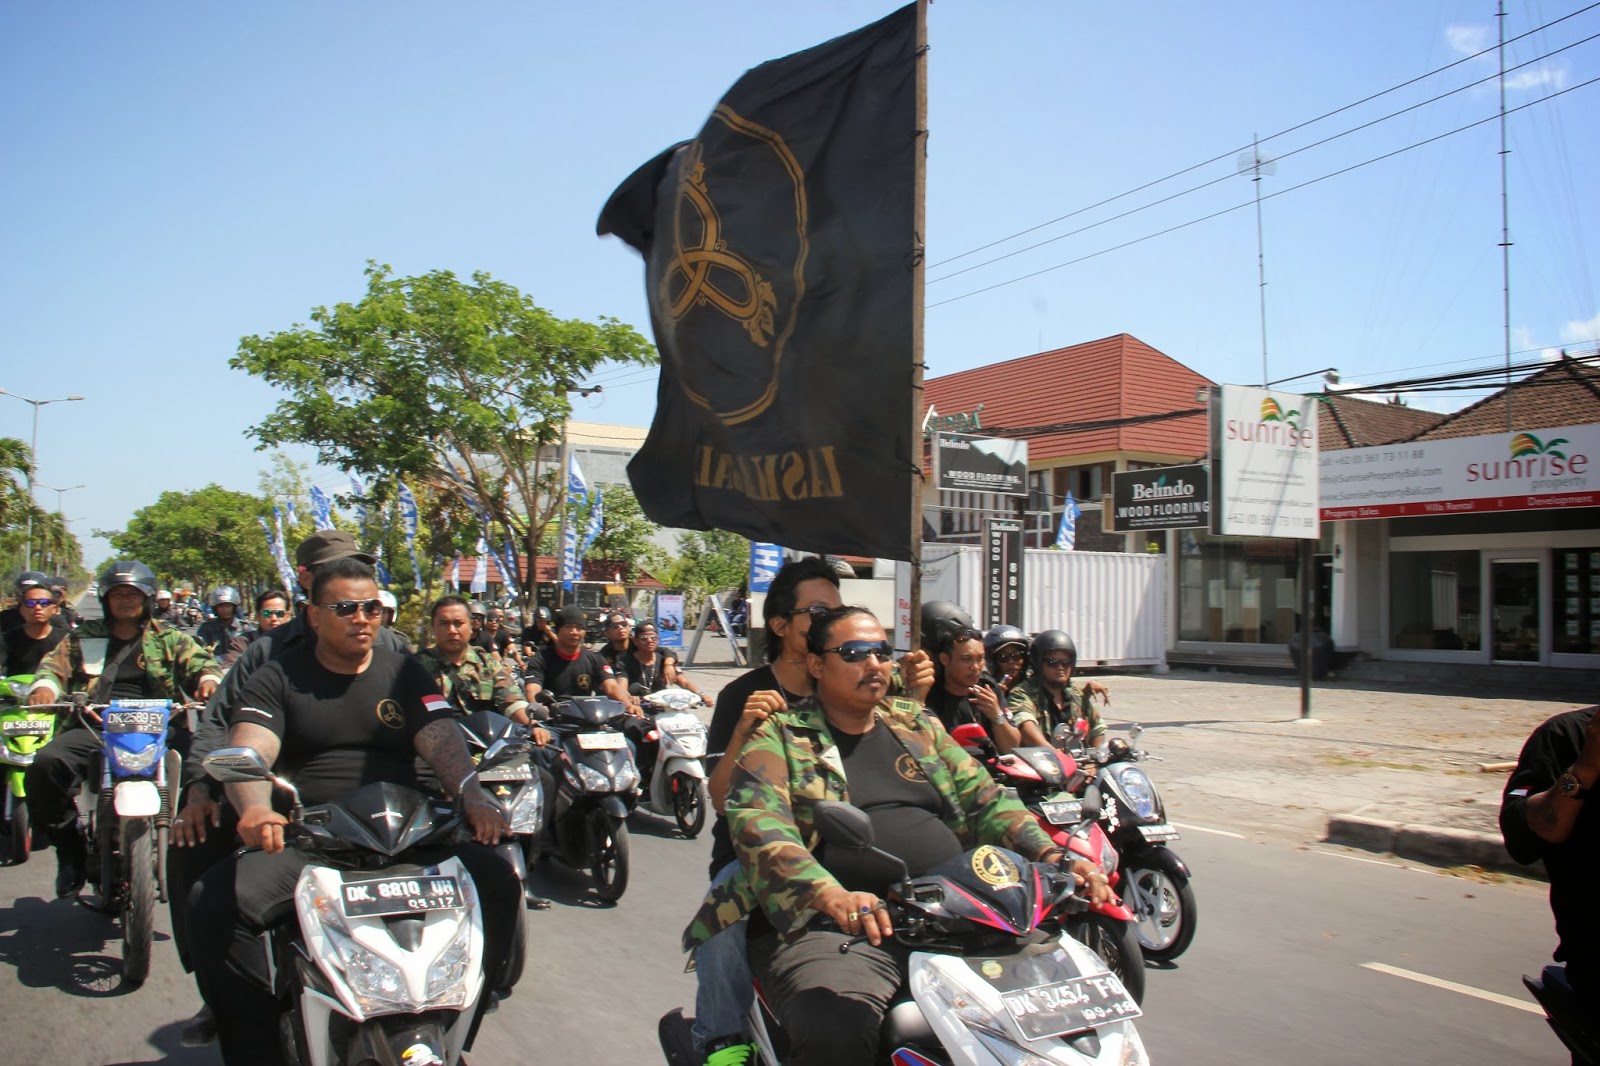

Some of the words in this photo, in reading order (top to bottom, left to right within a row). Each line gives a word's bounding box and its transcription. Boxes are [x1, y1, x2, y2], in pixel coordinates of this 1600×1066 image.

[1226, 419, 1313, 448] sunrise
[939, 438, 971, 450] Belindo
[948, 470, 975, 479] WOOD
[1466, 454, 1589, 482] sunrise
[1132, 479, 1194, 499] Belindo
[1531, 477, 1588, 492] property
[1118, 505, 1152, 517] WOOD
[1153, 501, 1211, 516] FLOORING
[1324, 510, 1358, 518] Property
[1359, 508, 1380, 516] Sales
[1527, 495, 1593, 507] Development
[991, 522, 1020, 532] Belindo
[991, 531, 1001, 561] WOOD
[3, 721, 15, 730] DK
[108, 713, 123, 724] DK
[124, 712, 149, 723] 2589
[150, 713, 164, 724] EY
[346, 885, 372, 901] DK
[378, 880, 421, 898] 8810
[1004, 994, 1039, 1017] DK
